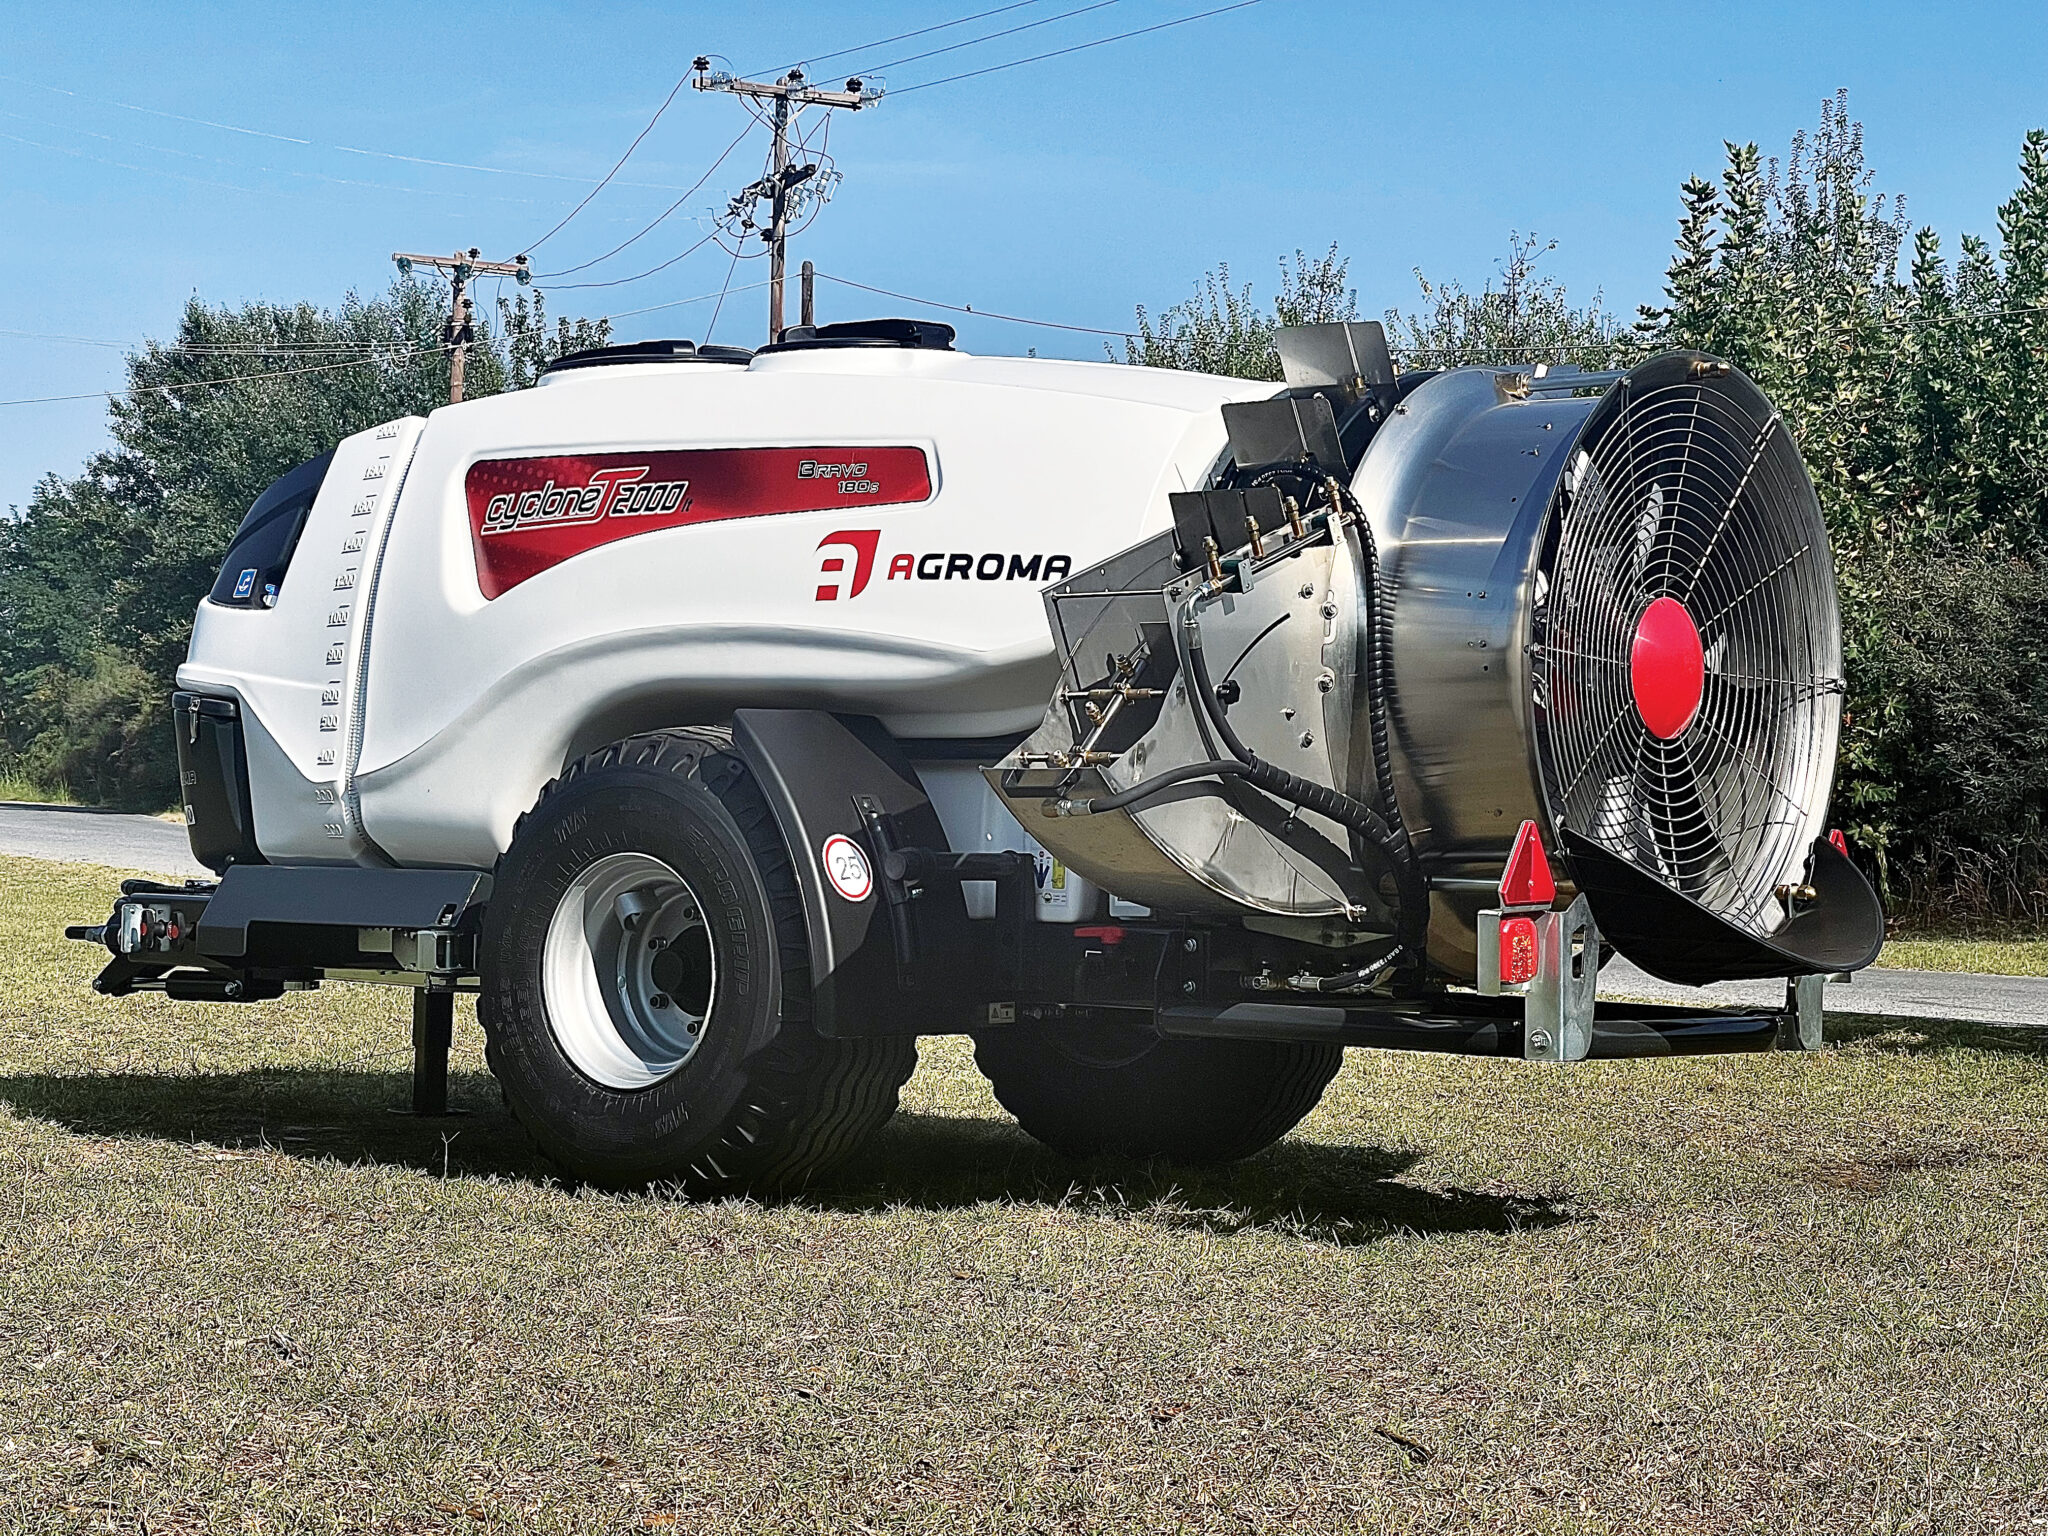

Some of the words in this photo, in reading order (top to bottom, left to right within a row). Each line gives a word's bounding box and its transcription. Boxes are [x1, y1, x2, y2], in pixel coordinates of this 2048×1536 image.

[887, 553, 1072, 581] AGROMA
[328, 611, 348, 624] 1000
[327, 649, 344, 662] 800
[322, 690, 341, 702] 600
[320, 715, 339, 728] 500
[836, 856, 862, 880] 25
